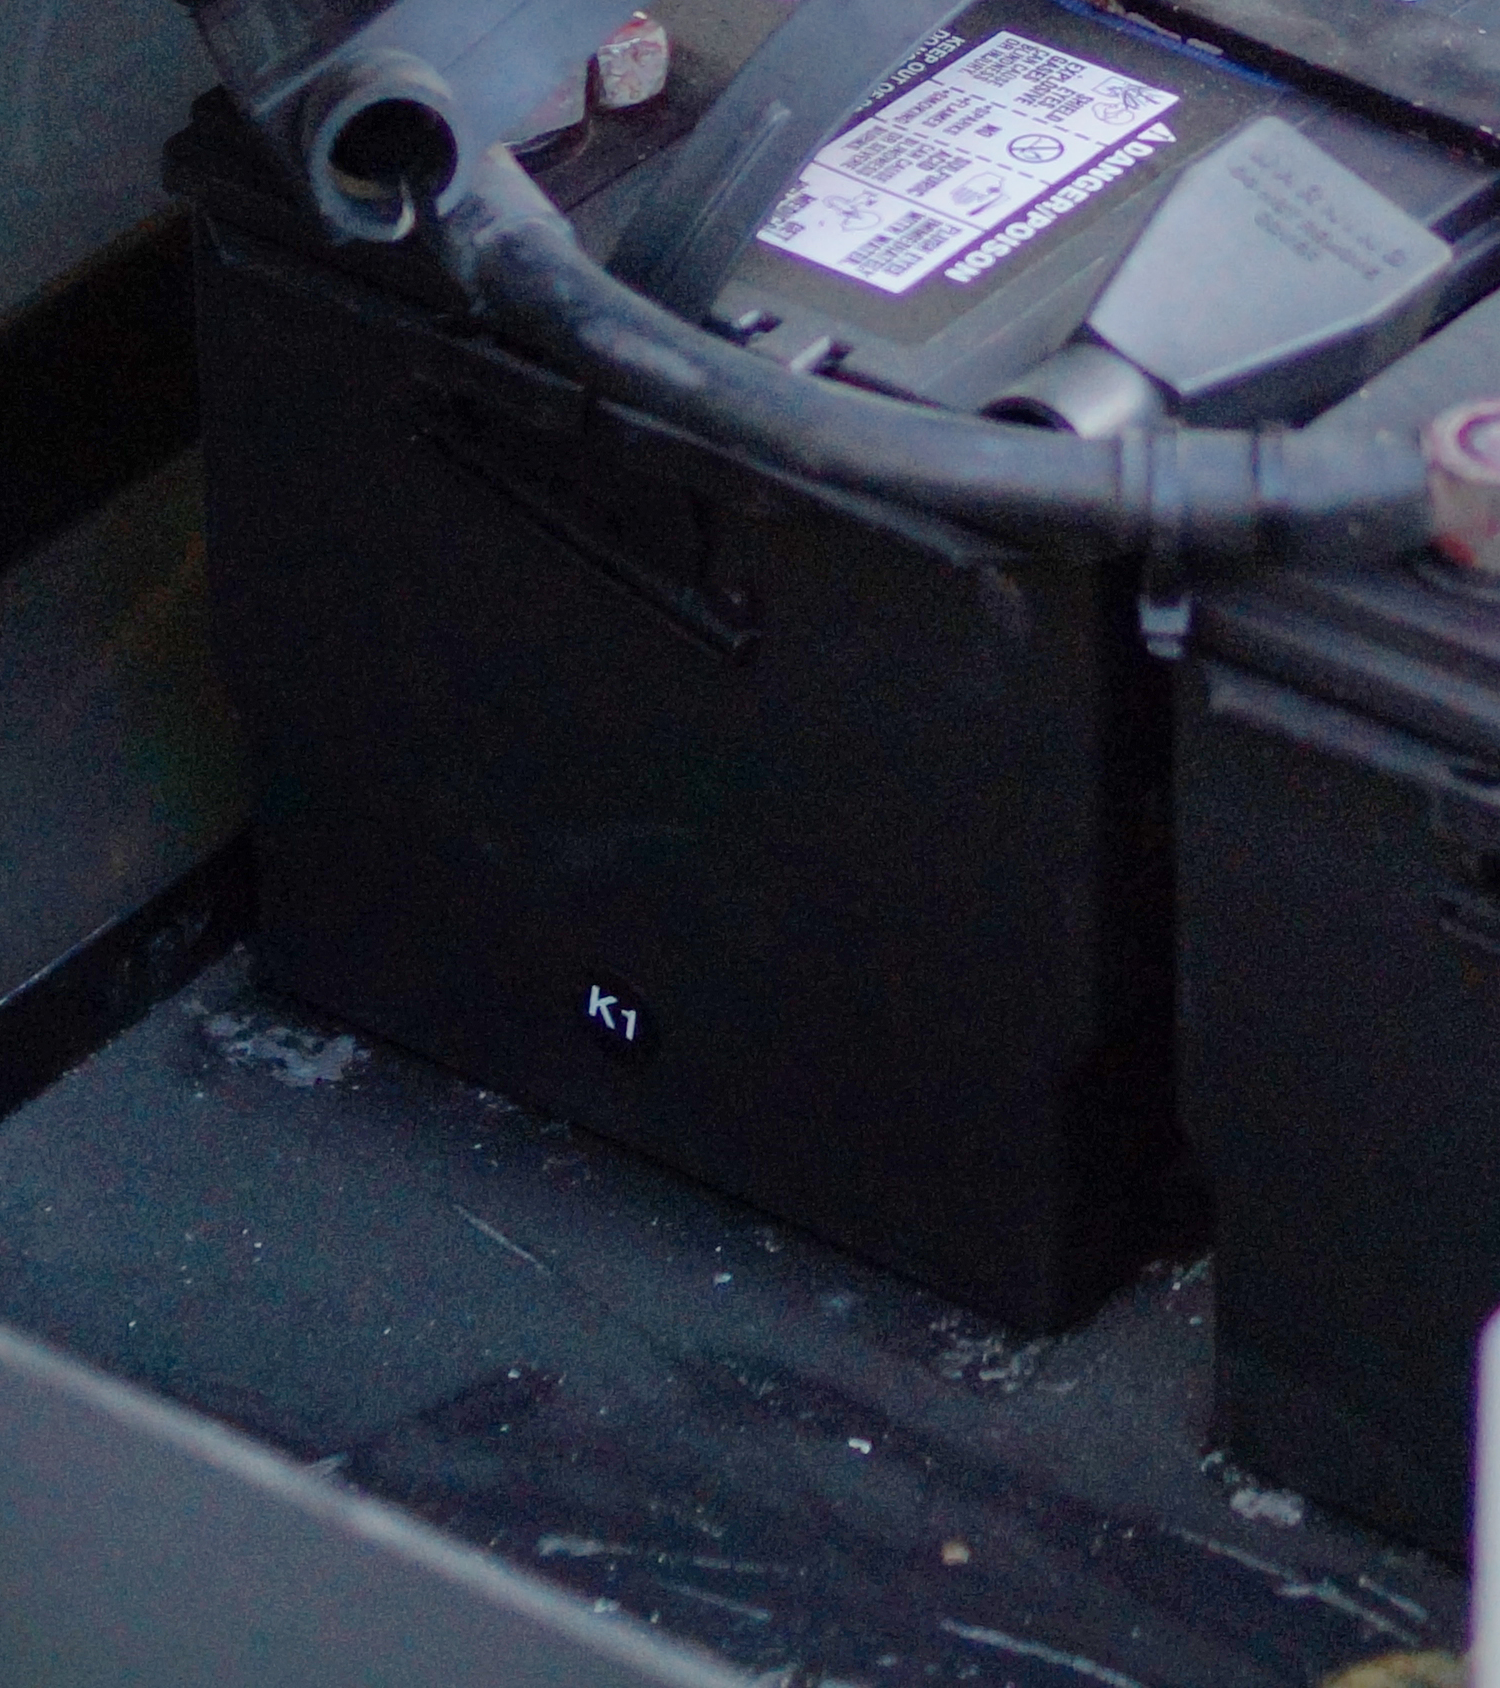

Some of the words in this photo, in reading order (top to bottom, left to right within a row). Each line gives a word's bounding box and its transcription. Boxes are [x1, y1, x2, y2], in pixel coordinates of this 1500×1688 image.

[925, 35, 965, 63] KEEP
[974, 43, 1037, 81] BLINDNESS
[1019, 47, 1049, 64] CAN
[891, 62, 925, 84] OUT
[986, 63, 1028, 87] CAUSE
[1023, 56, 1068, 82] GASES
[872, 83, 894, 98] OF
[1016, 62, 1086, 105] EXPLOSIVE
[1045, 93, 1094, 122] SHIELD
[945, 142, 1153, 282] DANGER/POISON
[588, 984, 637, 1042] K1
